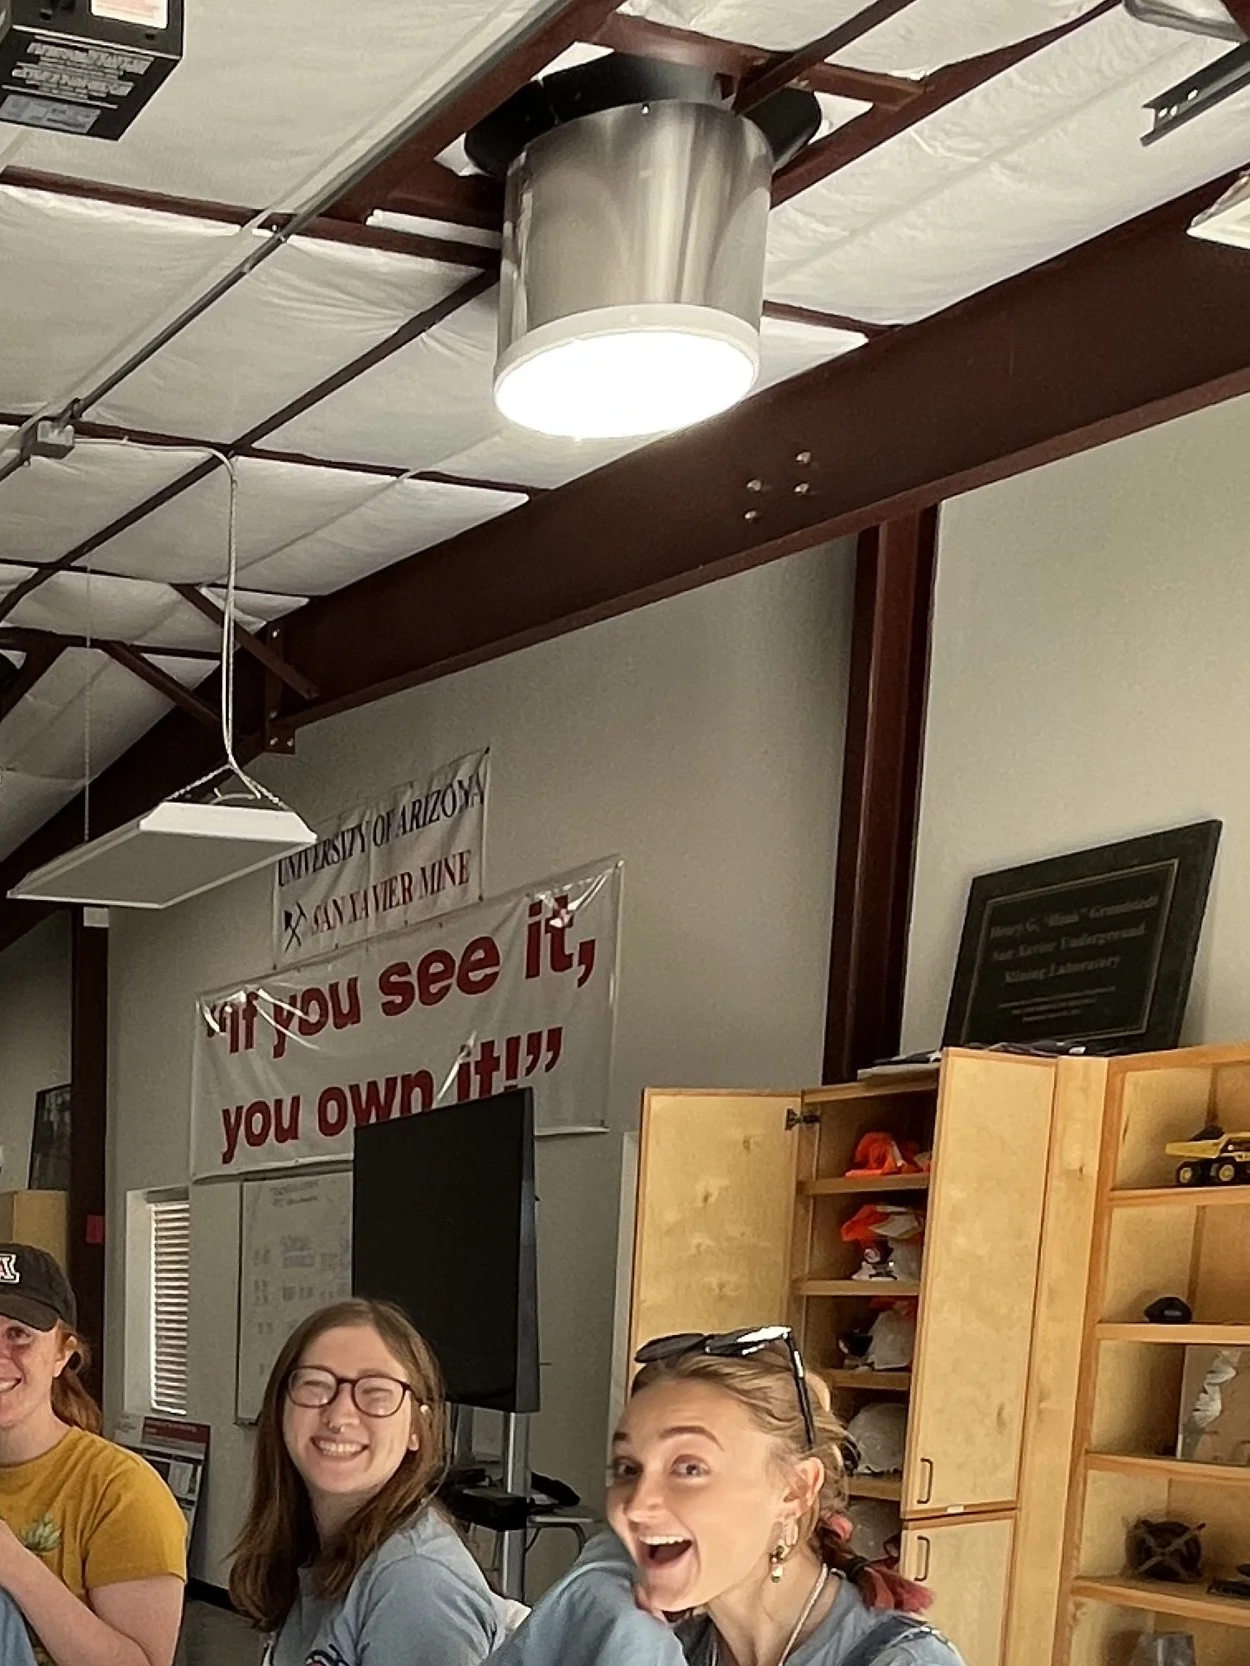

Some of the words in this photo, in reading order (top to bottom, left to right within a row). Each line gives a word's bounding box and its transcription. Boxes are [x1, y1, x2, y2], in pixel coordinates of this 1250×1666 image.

[277, 819, 371, 888] UNIVERSITY
[372, 807, 396, 848] OF
[398, 771, 484, 836] ARIZONA
[310, 897, 345, 936] SAN
[348, 870, 414, 925] XAVIER
[418, 848, 471, 900] MINE
[272, 975, 361, 1060] you
[377, 934, 502, 1017] see
[524, 894, 597, 989] it,
[221, 1094, 301, 1165] you
[316, 1068, 435, 1138] own
